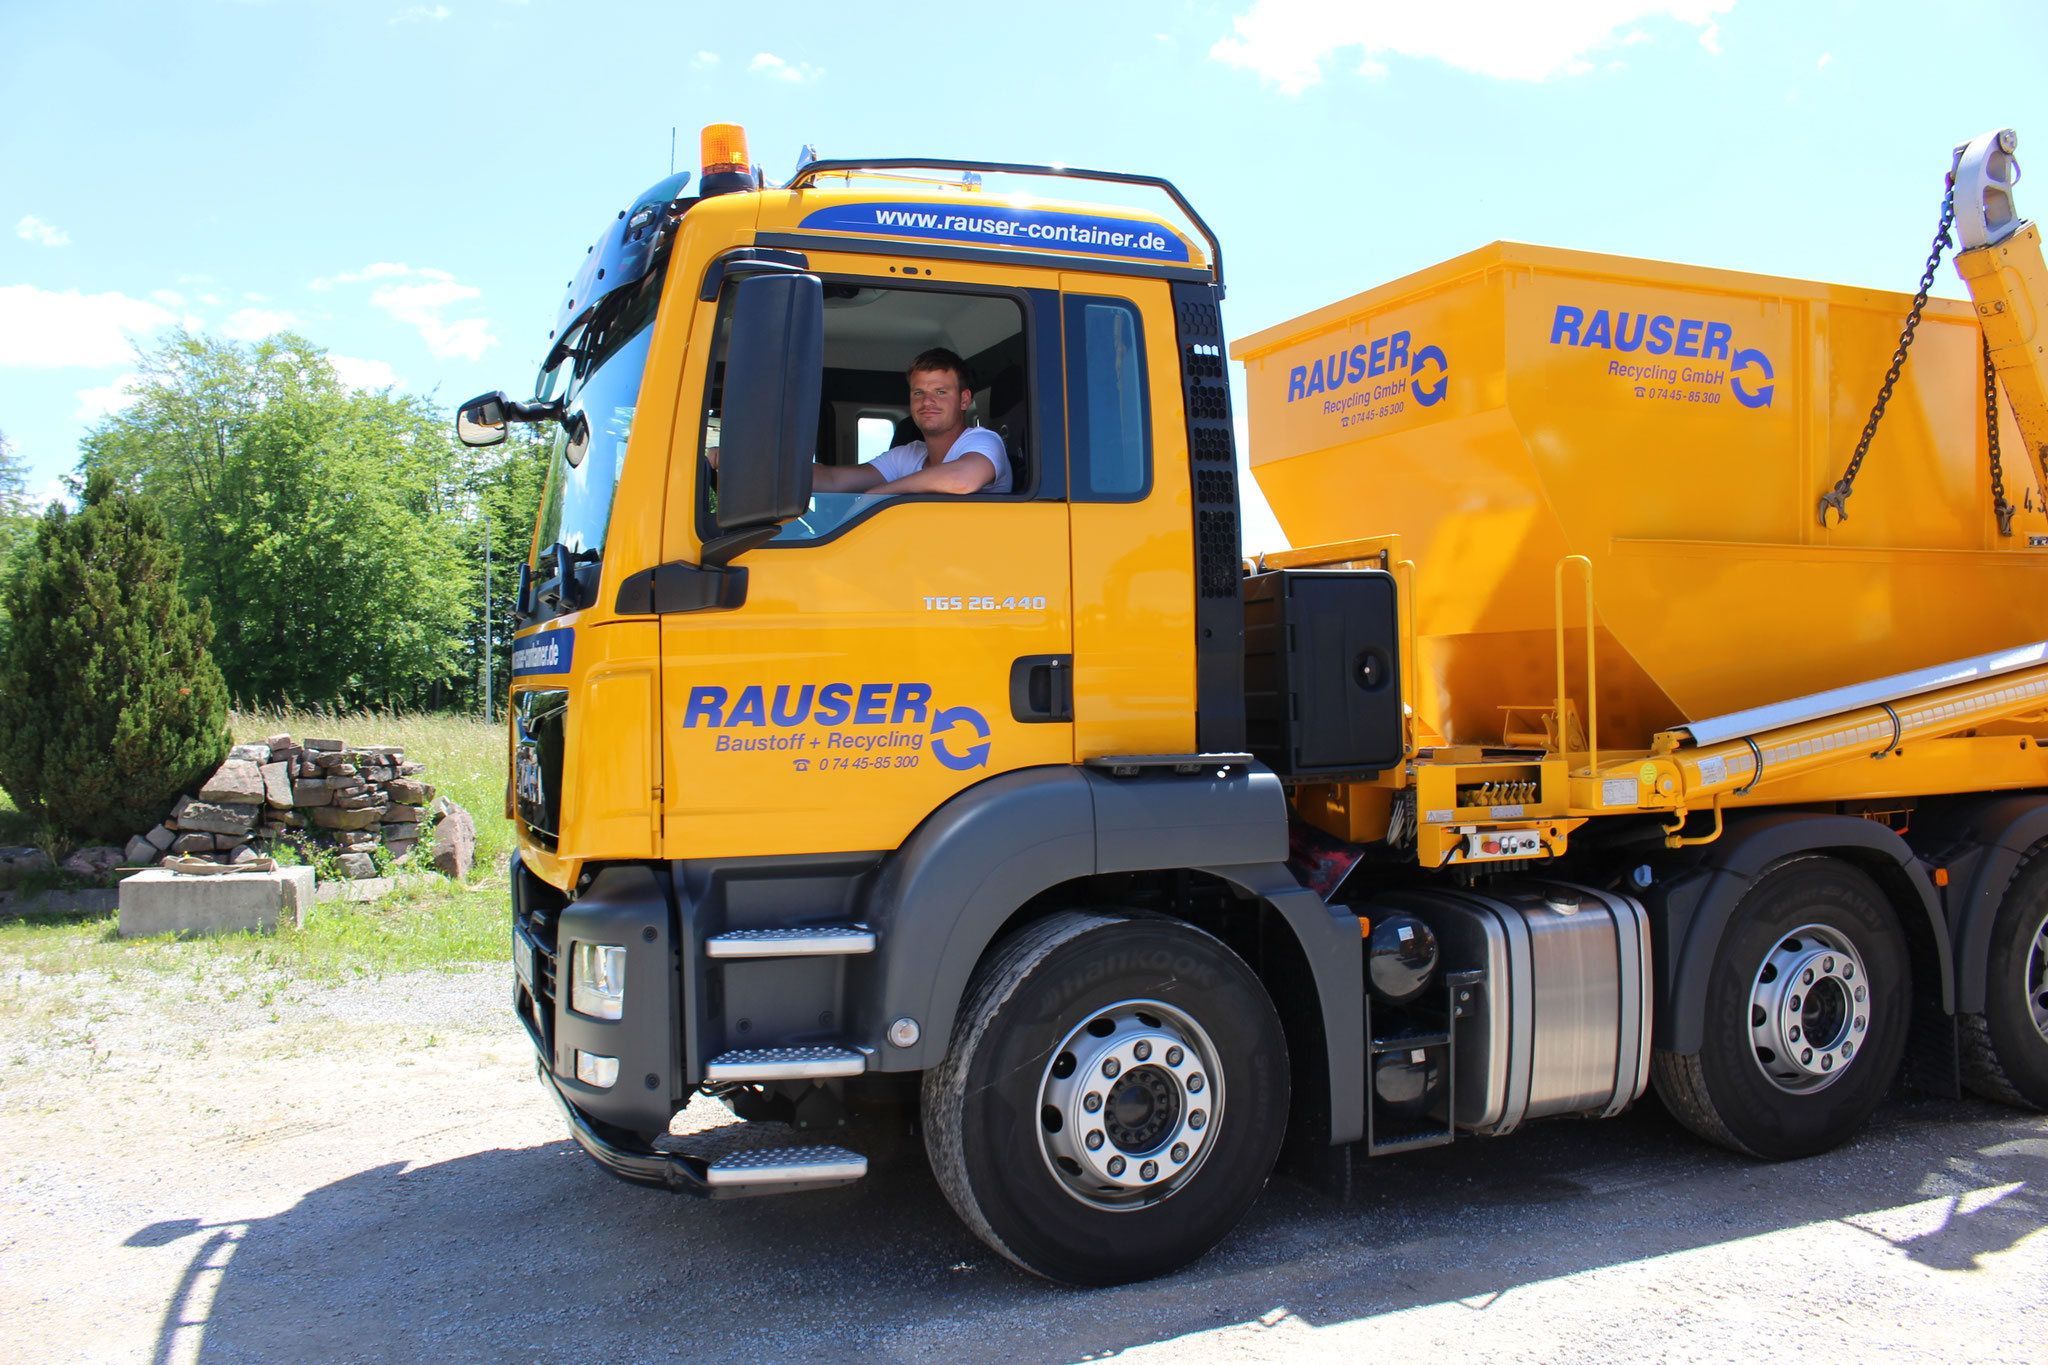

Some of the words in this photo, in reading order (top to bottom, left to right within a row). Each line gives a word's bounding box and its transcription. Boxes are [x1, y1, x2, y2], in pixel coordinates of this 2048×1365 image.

[875, 209, 1167, 250] www.rauser-container.de
[1549, 304, 1733, 360] RAUSER
[1287, 330, 1411, 403] RAUSER
[1608, 360, 1678, 385] Recycling
[1681, 367, 1725, 385] GmbH
[1323, 391, 1371, 415] Recycling
[1373, 377, 1407, 401] GmbH
[922, 596, 962, 610] TGS
[968, 596, 1046, 610] 26.440
[683, 683, 932, 728] RAUSER
[715, 733, 806, 752] Baustoff
[827, 731, 924, 751] Recycling
[894, 755, 919, 769] 300
